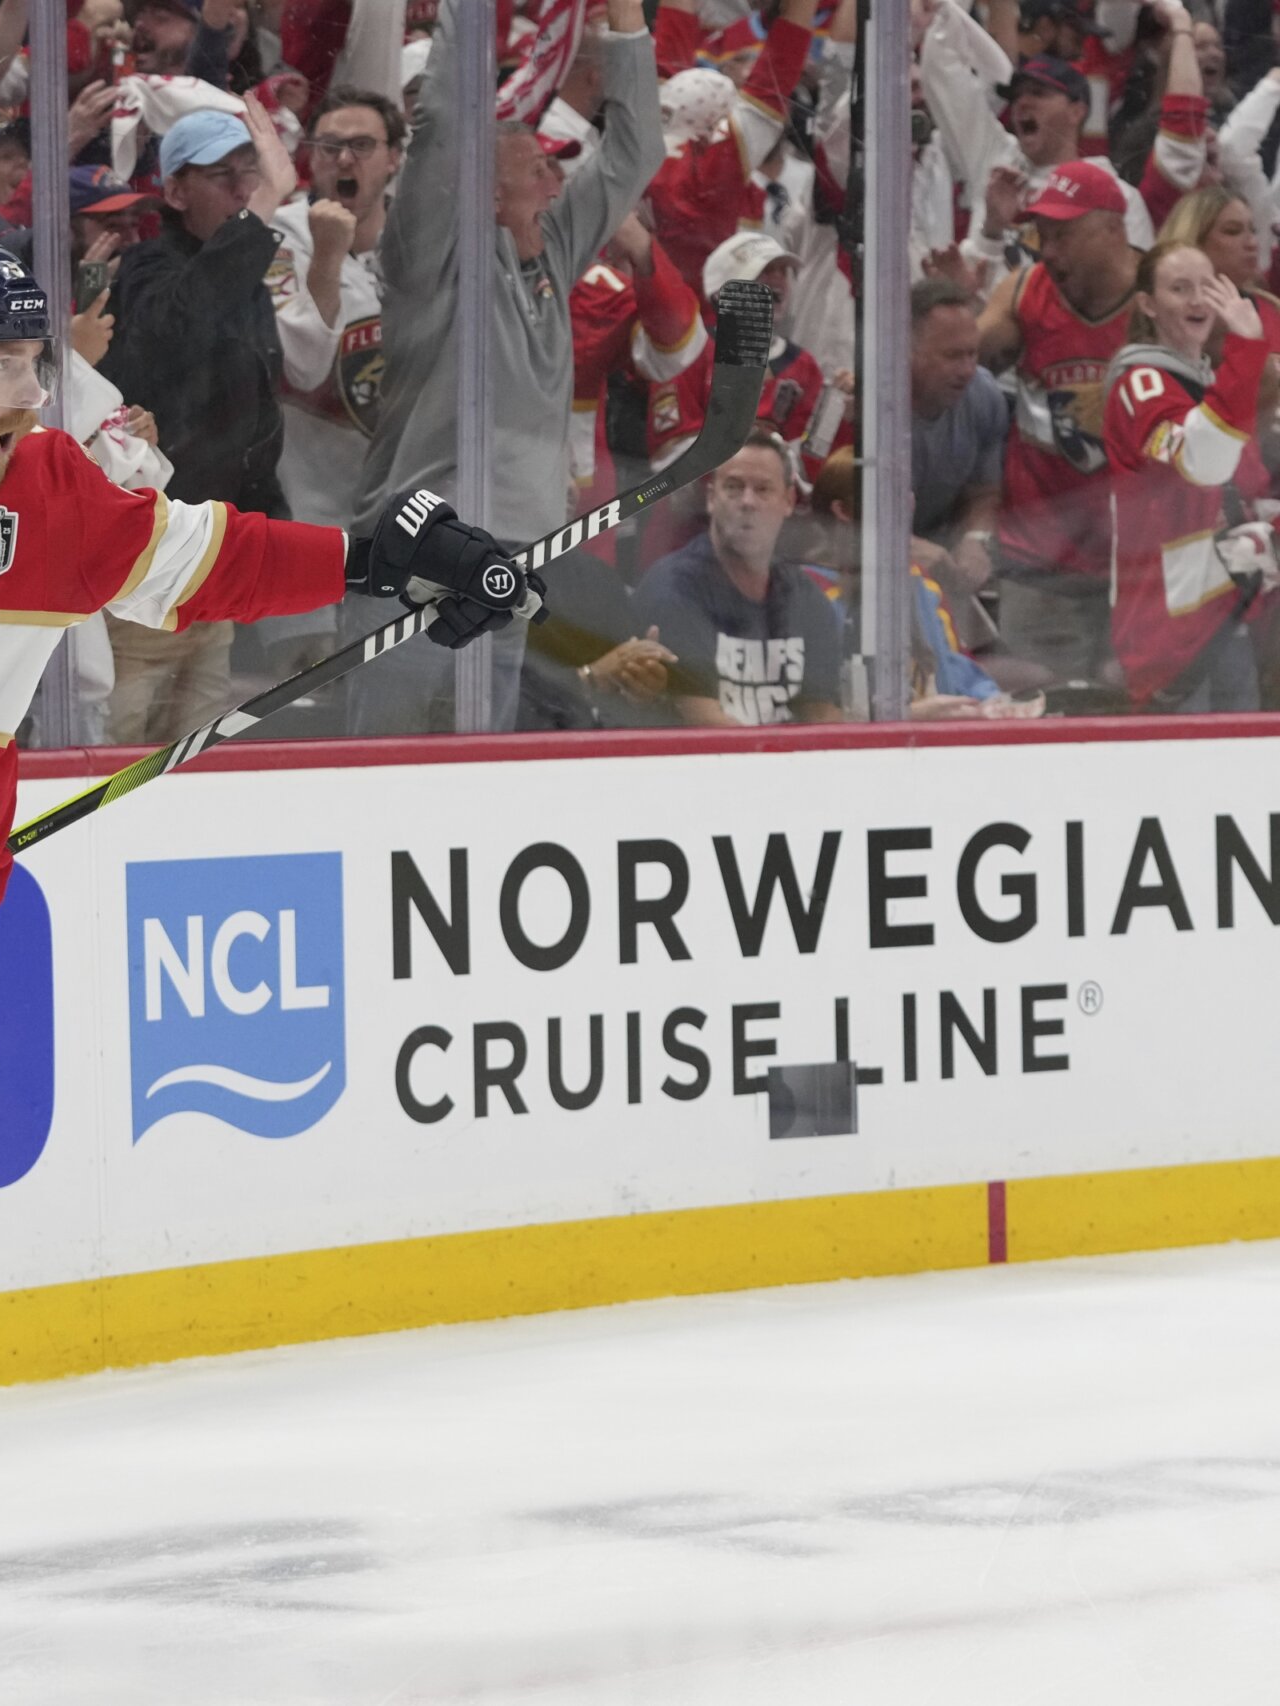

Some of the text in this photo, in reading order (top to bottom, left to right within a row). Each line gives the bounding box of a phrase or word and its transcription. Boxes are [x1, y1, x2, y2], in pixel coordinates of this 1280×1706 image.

[10, 299, 45, 312] CCM
[391, 811, 1280, 981] NORWEGIAN
[143, 909, 330, 1022] NCL
[395, 1001, 781, 1125] CRUISE
[834, 983, 1070, 1085] LINE
